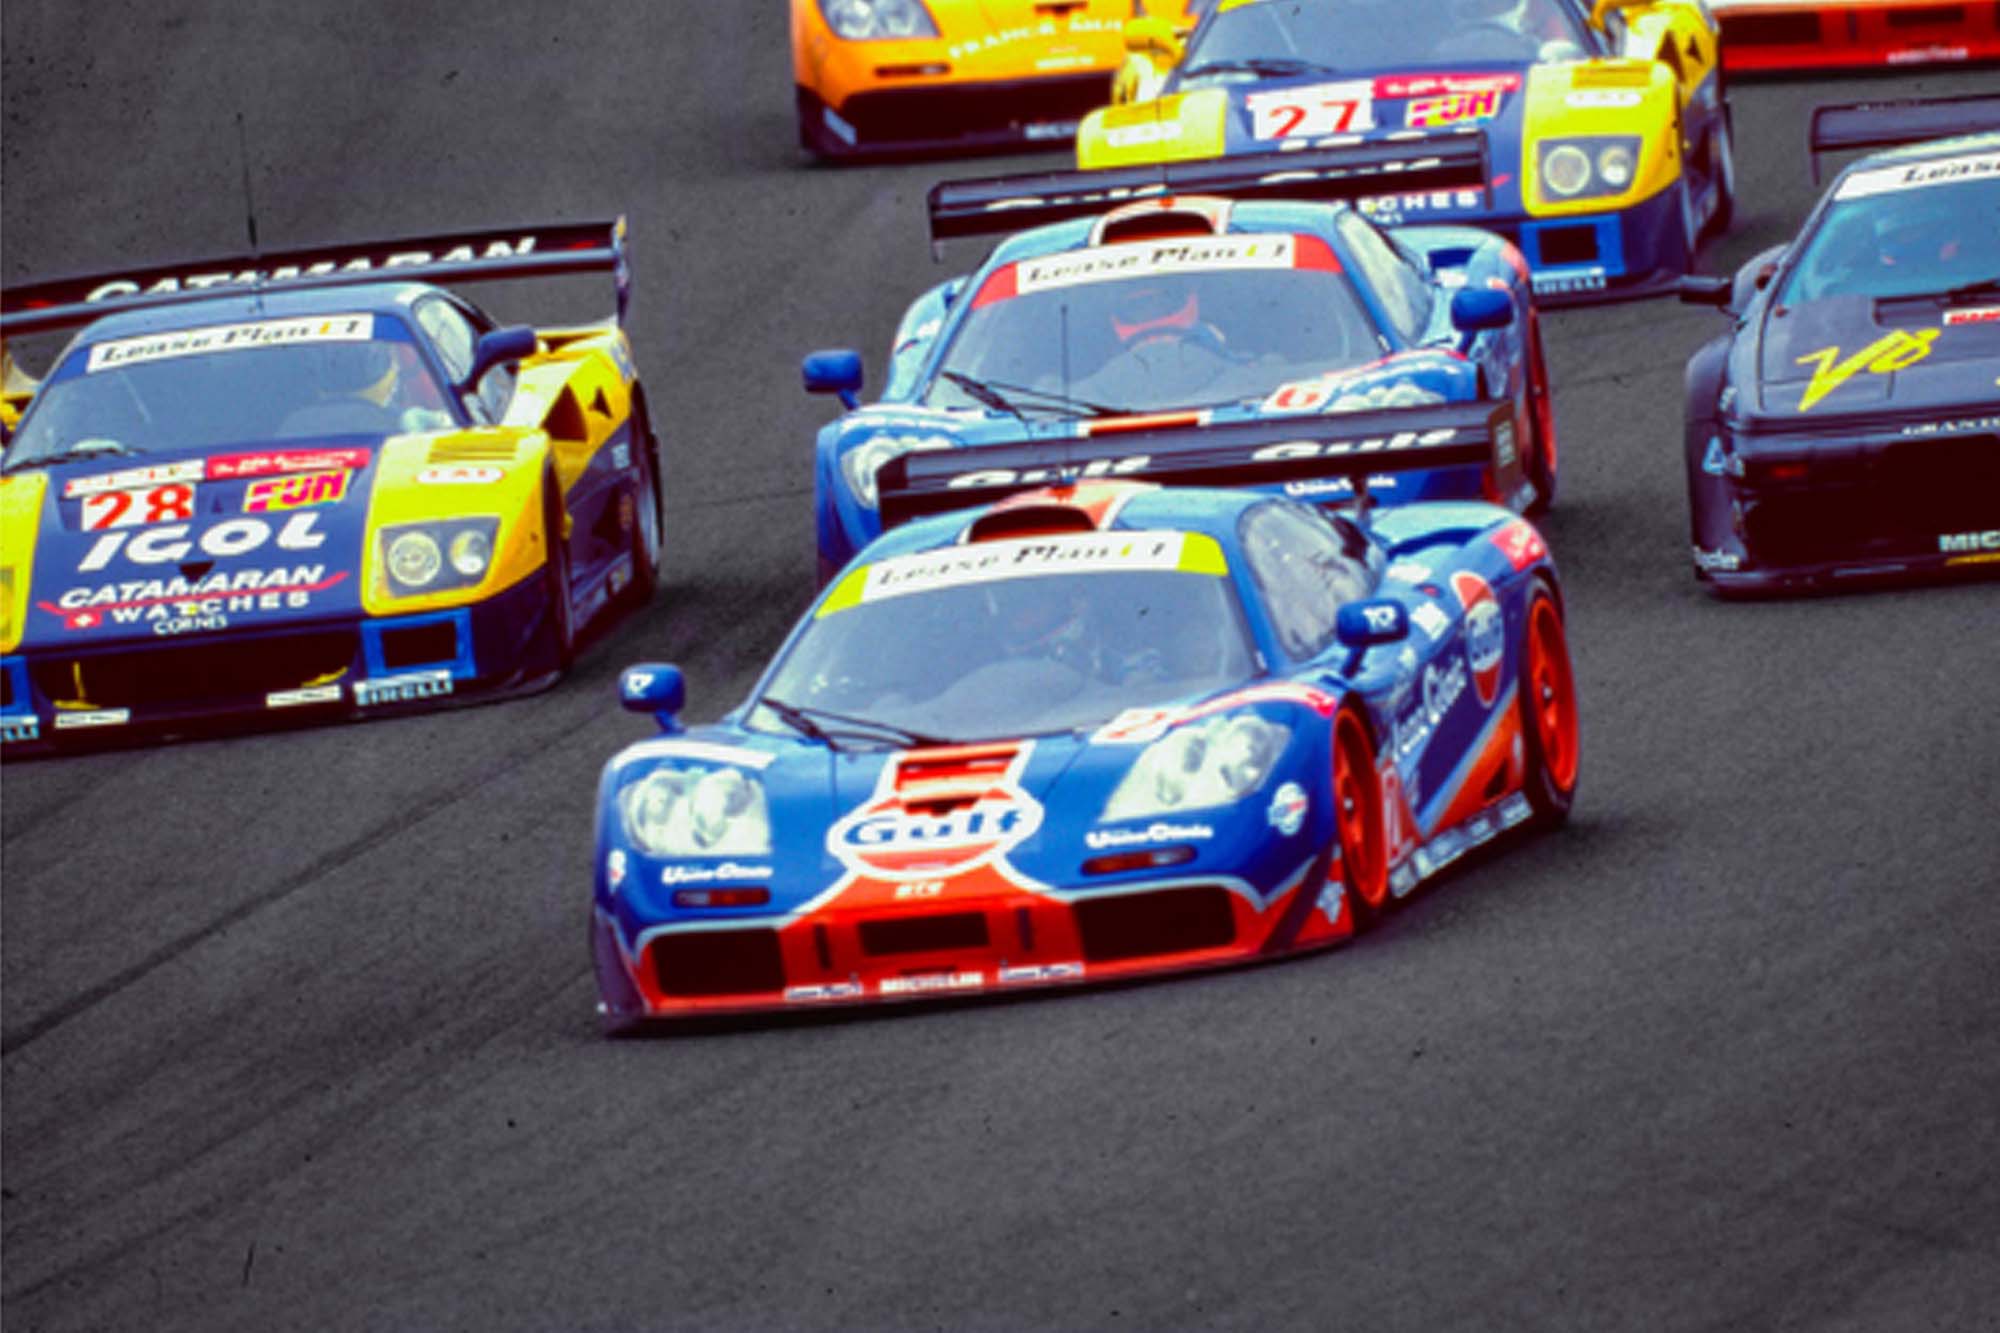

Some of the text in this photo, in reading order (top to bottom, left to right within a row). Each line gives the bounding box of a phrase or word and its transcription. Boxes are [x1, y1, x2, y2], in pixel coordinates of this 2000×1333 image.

[1269, 101, 1362, 139] 27
[1795, 329, 1941, 412] V8
[87, 483, 193, 529] 28
[247, 473, 346, 513] FUN
[78, 513, 326, 572] IGOL
[59, 565, 326, 608] CATAMARAN
[111, 593, 310, 625] WATCHES
[355, 678, 454, 706] PIRELLI
[844, 810, 1023, 846] Gulf
